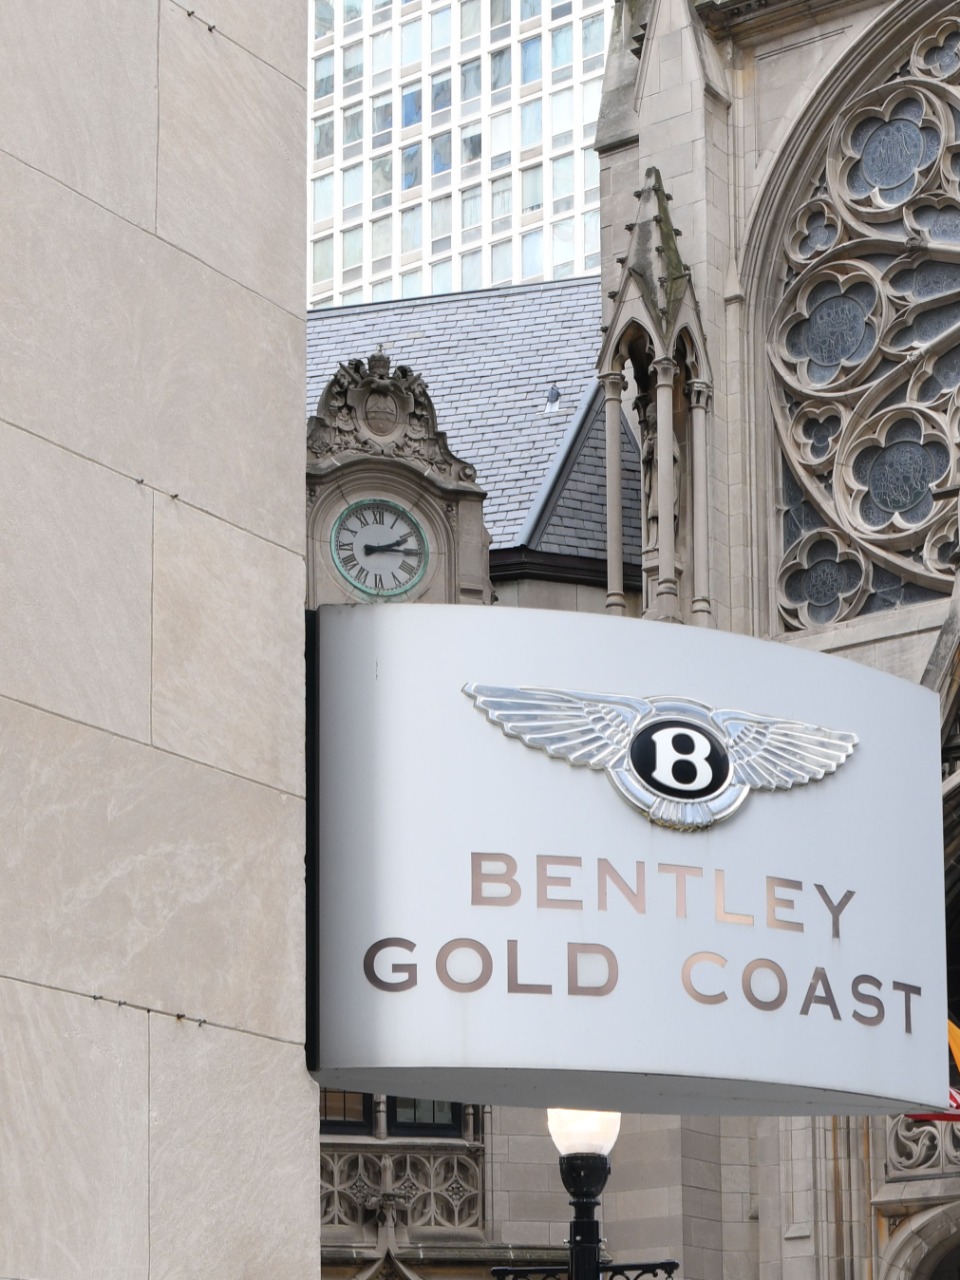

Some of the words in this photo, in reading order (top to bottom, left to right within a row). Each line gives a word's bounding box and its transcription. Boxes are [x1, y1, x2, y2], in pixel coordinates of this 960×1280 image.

[650, 727, 714, 792] B
[470, 852, 856, 939] BENTLEY
[363, 936, 619, 997] GOLD
[681, 951, 922, 1034] COAST
